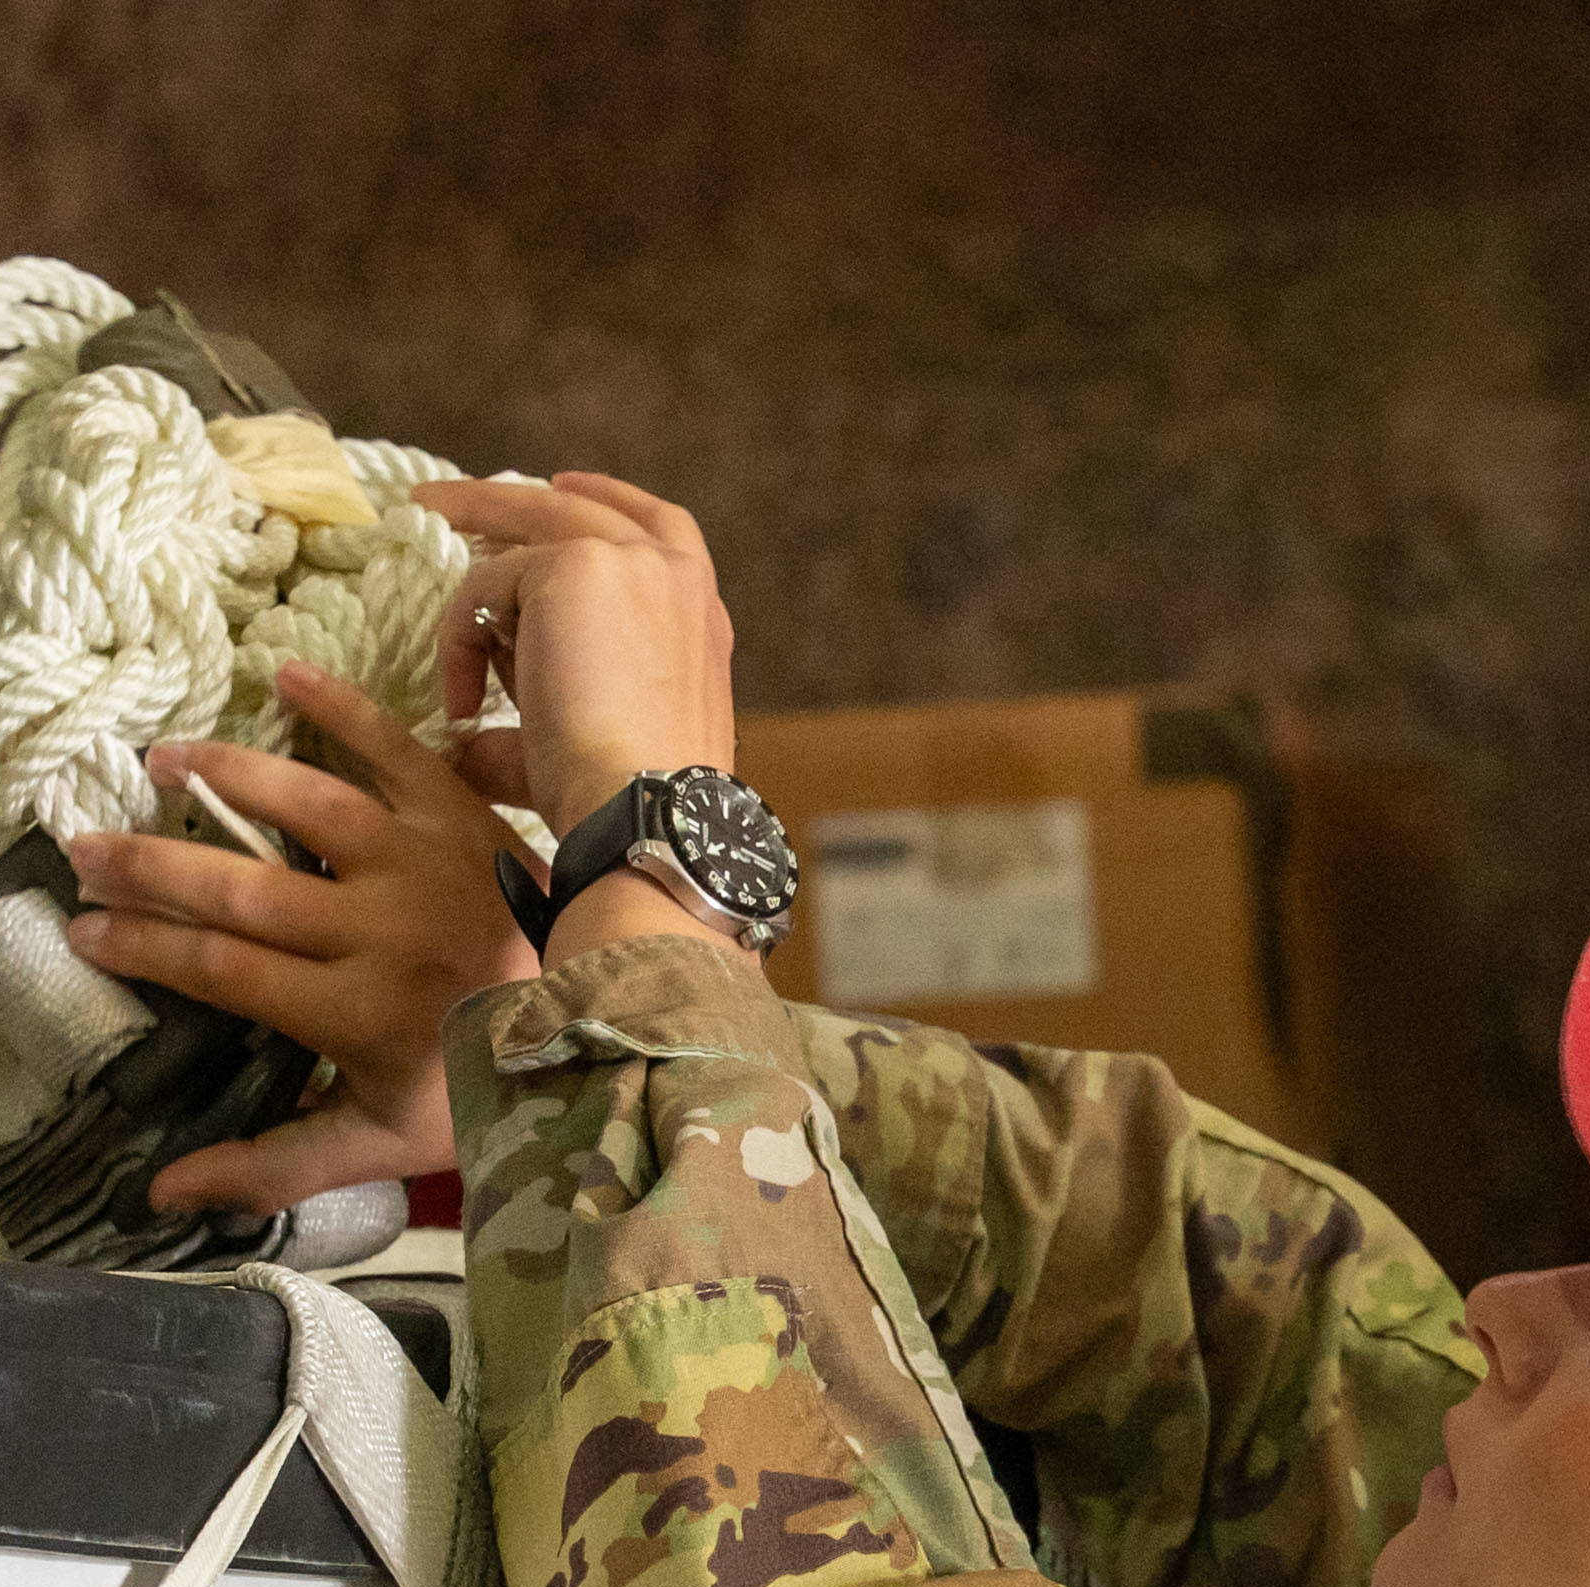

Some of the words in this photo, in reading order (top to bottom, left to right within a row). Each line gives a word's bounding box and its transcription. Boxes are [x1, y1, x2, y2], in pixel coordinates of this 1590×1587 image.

[674, 781, 687, 796] 5
[737, 891, 757, 907] 45
[766, 896, 781, 910] 40
